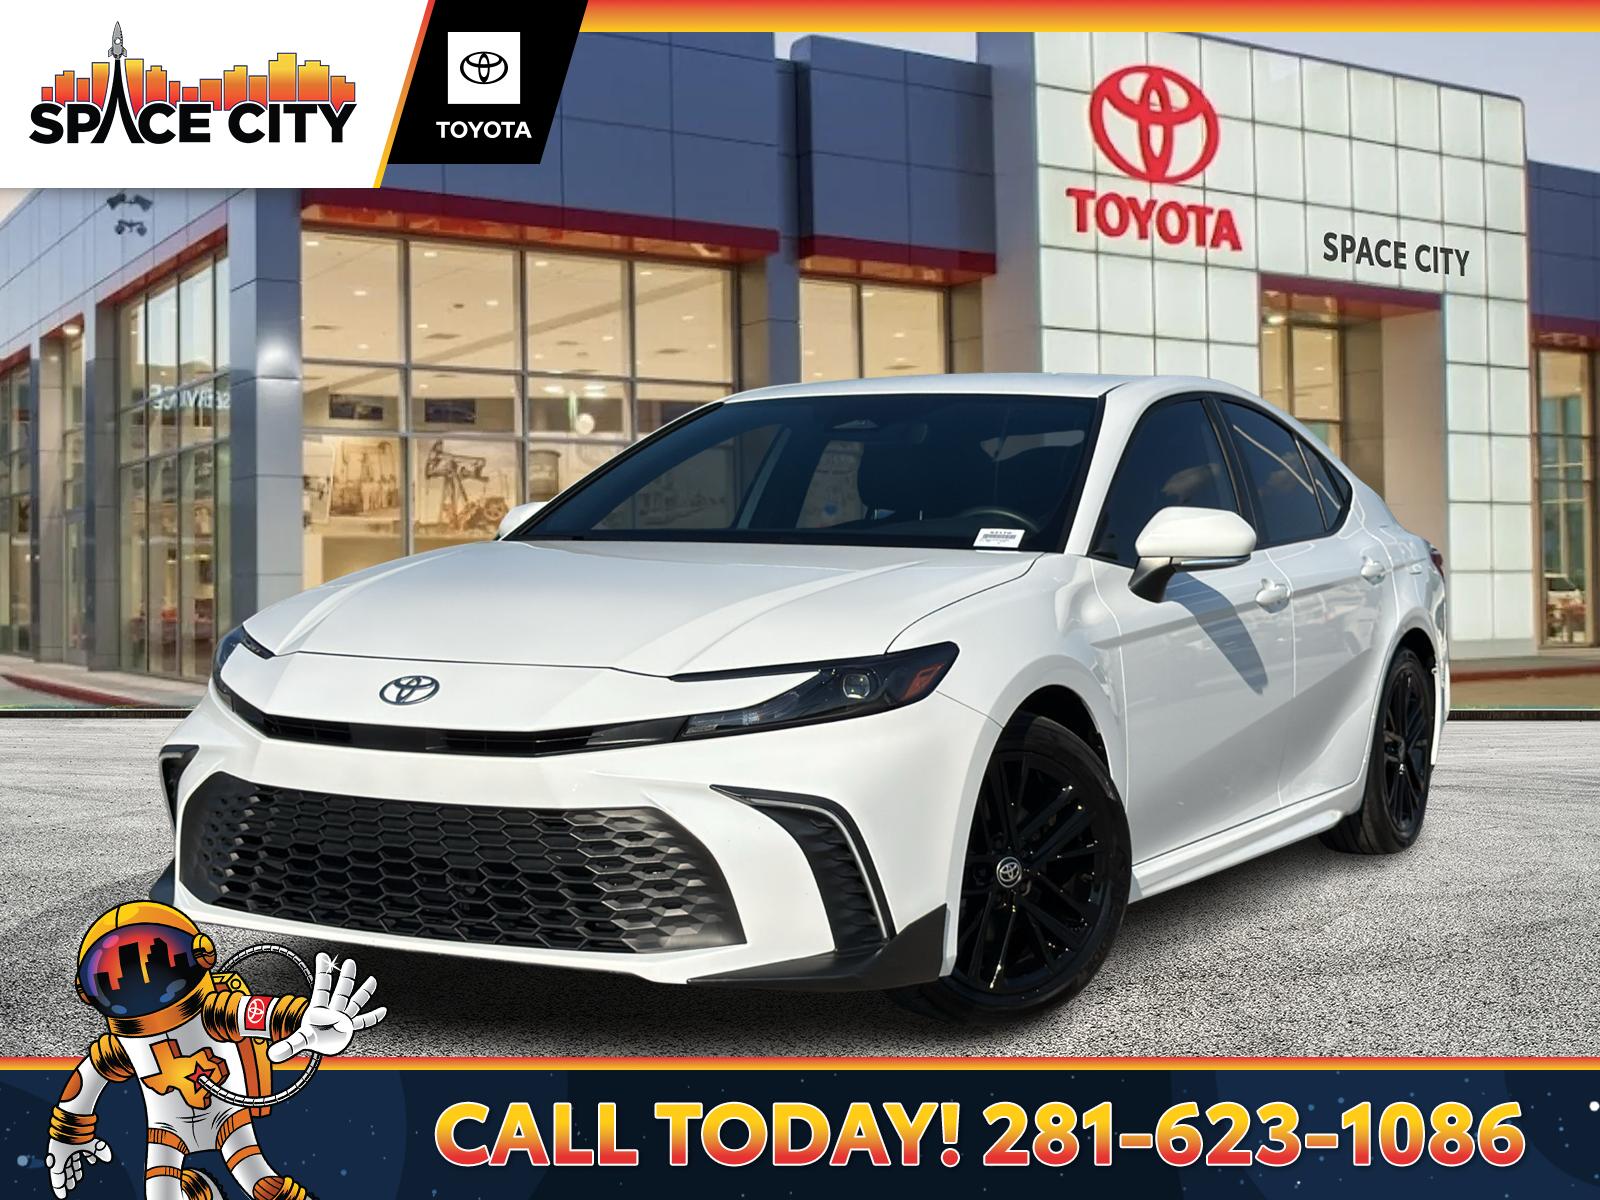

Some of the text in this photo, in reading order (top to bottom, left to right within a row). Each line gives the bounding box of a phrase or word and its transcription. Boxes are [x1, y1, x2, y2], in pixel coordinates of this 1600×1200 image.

[1066, 187, 1242, 251] TOYOTA
[1323, 231, 1470, 277] SPACE CITY
